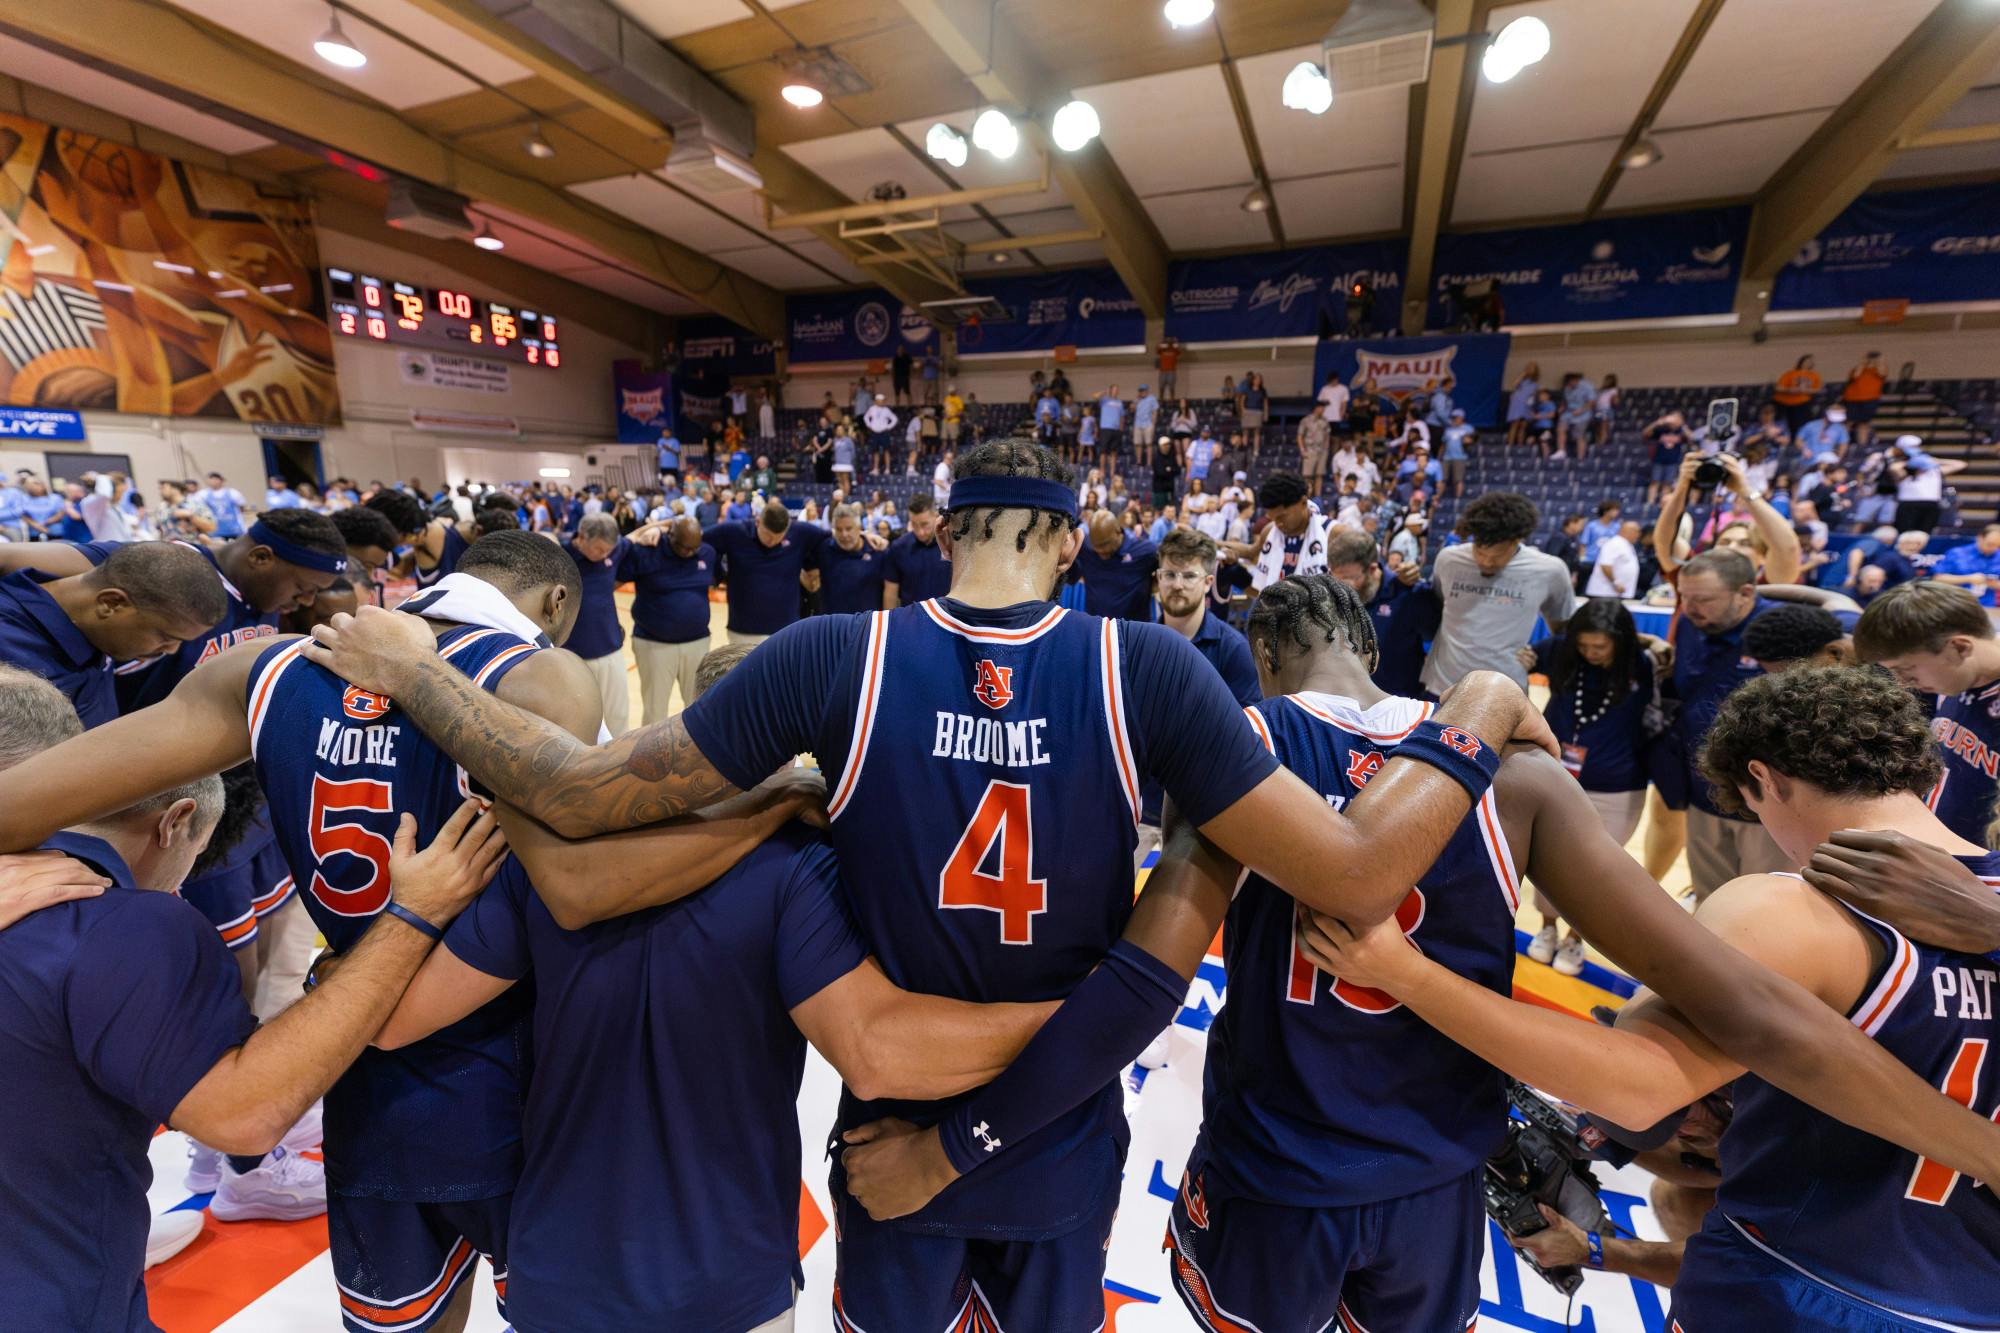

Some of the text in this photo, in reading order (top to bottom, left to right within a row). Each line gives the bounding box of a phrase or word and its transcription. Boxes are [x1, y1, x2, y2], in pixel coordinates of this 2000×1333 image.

[364, 286, 380, 307] 0
[393, 293, 423, 322] 72
[340, 312, 355, 335] 2
[469, 323, 483, 344] 2
[526, 345, 539, 364] 2
[1366, 357, 1442, 379] MAUI
[0, 419, 58, 435] LIVE
[1451, 582, 1525, 600] BASKETBALL
[315, 716, 401, 767] MOORE
[932, 711, 1050, 767] BROOME
[308, 771, 394, 917] 5
[938, 778, 1048, 945] 4
[1931, 965, 2000, 1021] PAT
